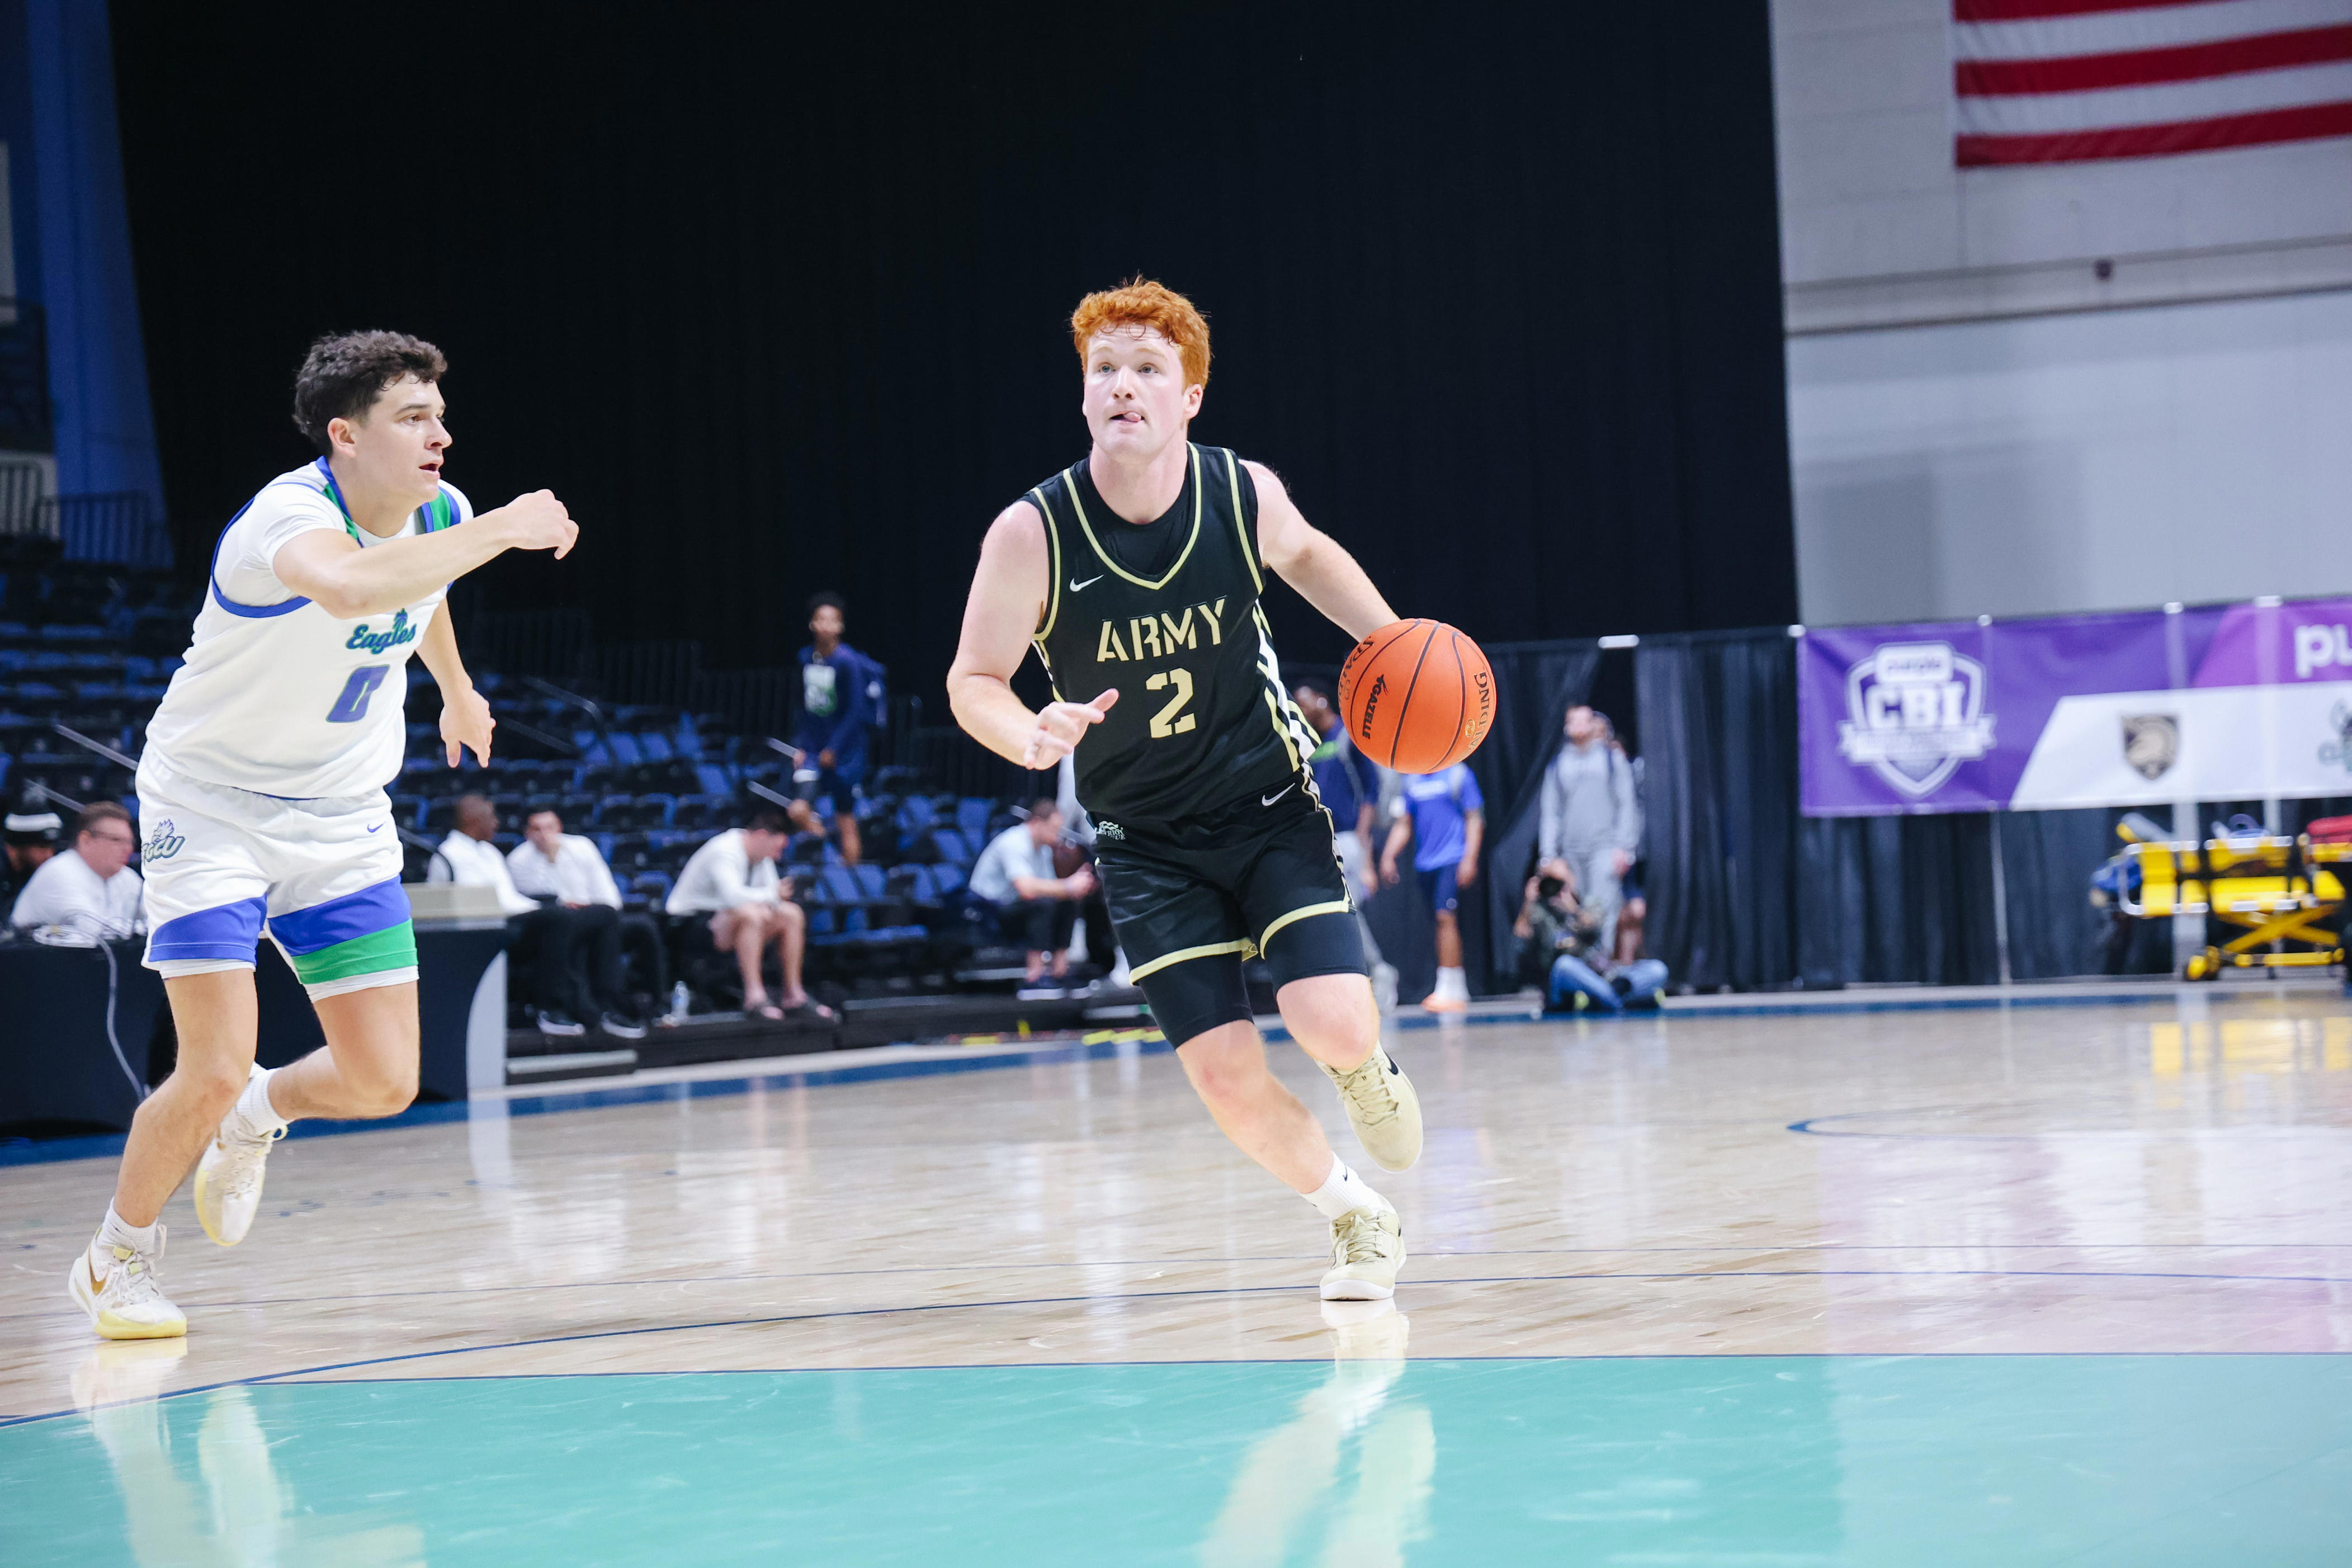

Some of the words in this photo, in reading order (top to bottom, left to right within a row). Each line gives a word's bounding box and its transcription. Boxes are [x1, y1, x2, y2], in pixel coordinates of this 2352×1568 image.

[346, 608, 417, 654] Eagles
[1097, 596, 1226, 662] ARMY
[327, 664, 390, 723] 0
[1146, 668, 1196, 738] 2
[1362, 683, 1382, 740] GAZELLE
[1452, 672, 1490, 759] PALDING
[1865, 681, 1966, 729] CBI
